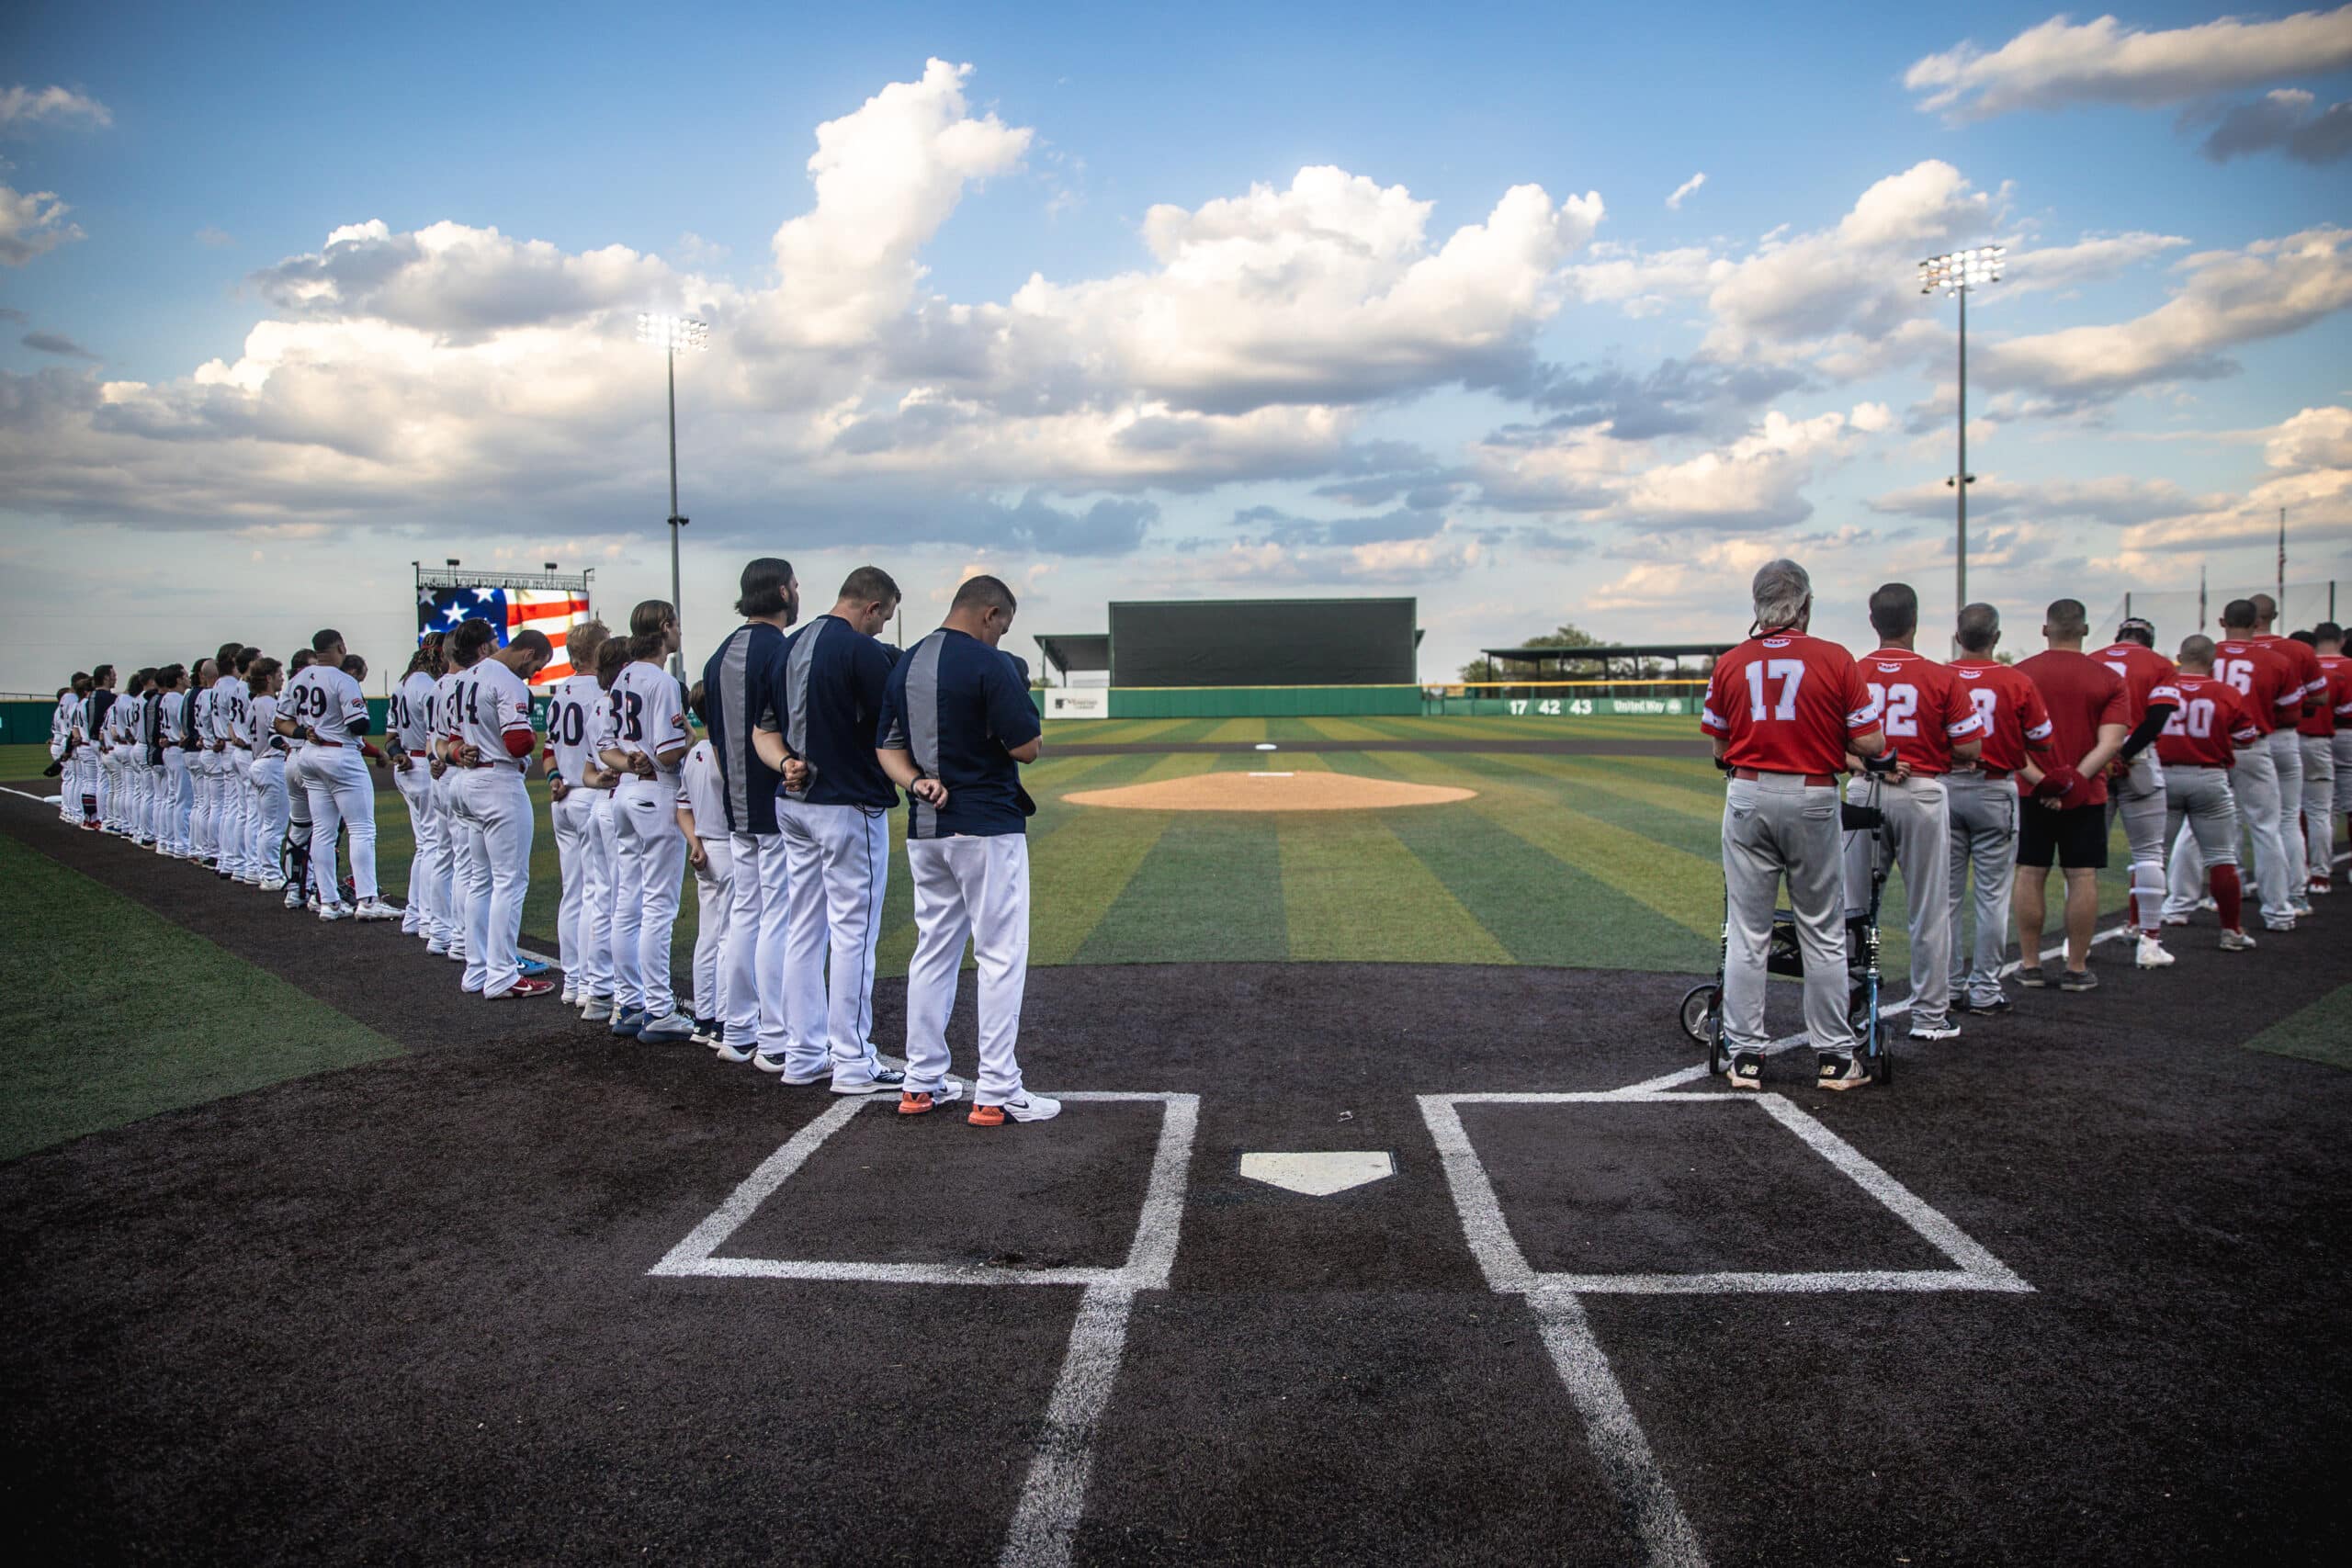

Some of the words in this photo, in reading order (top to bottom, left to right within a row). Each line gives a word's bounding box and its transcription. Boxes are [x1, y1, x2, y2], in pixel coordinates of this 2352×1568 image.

[293, 684, 327, 718] 29
[1510, 699, 1527, 715] 17
[1538, 699, 1561, 715] 42
[1569, 699, 1592, 715] 43
[1613, 700, 1645, 714] United
[1645, 700, 1665, 714] Way
[1746, 659, 1806, 721] 17
[548, 700, 584, 746] 20
[2162, 697, 2215, 738] 20
